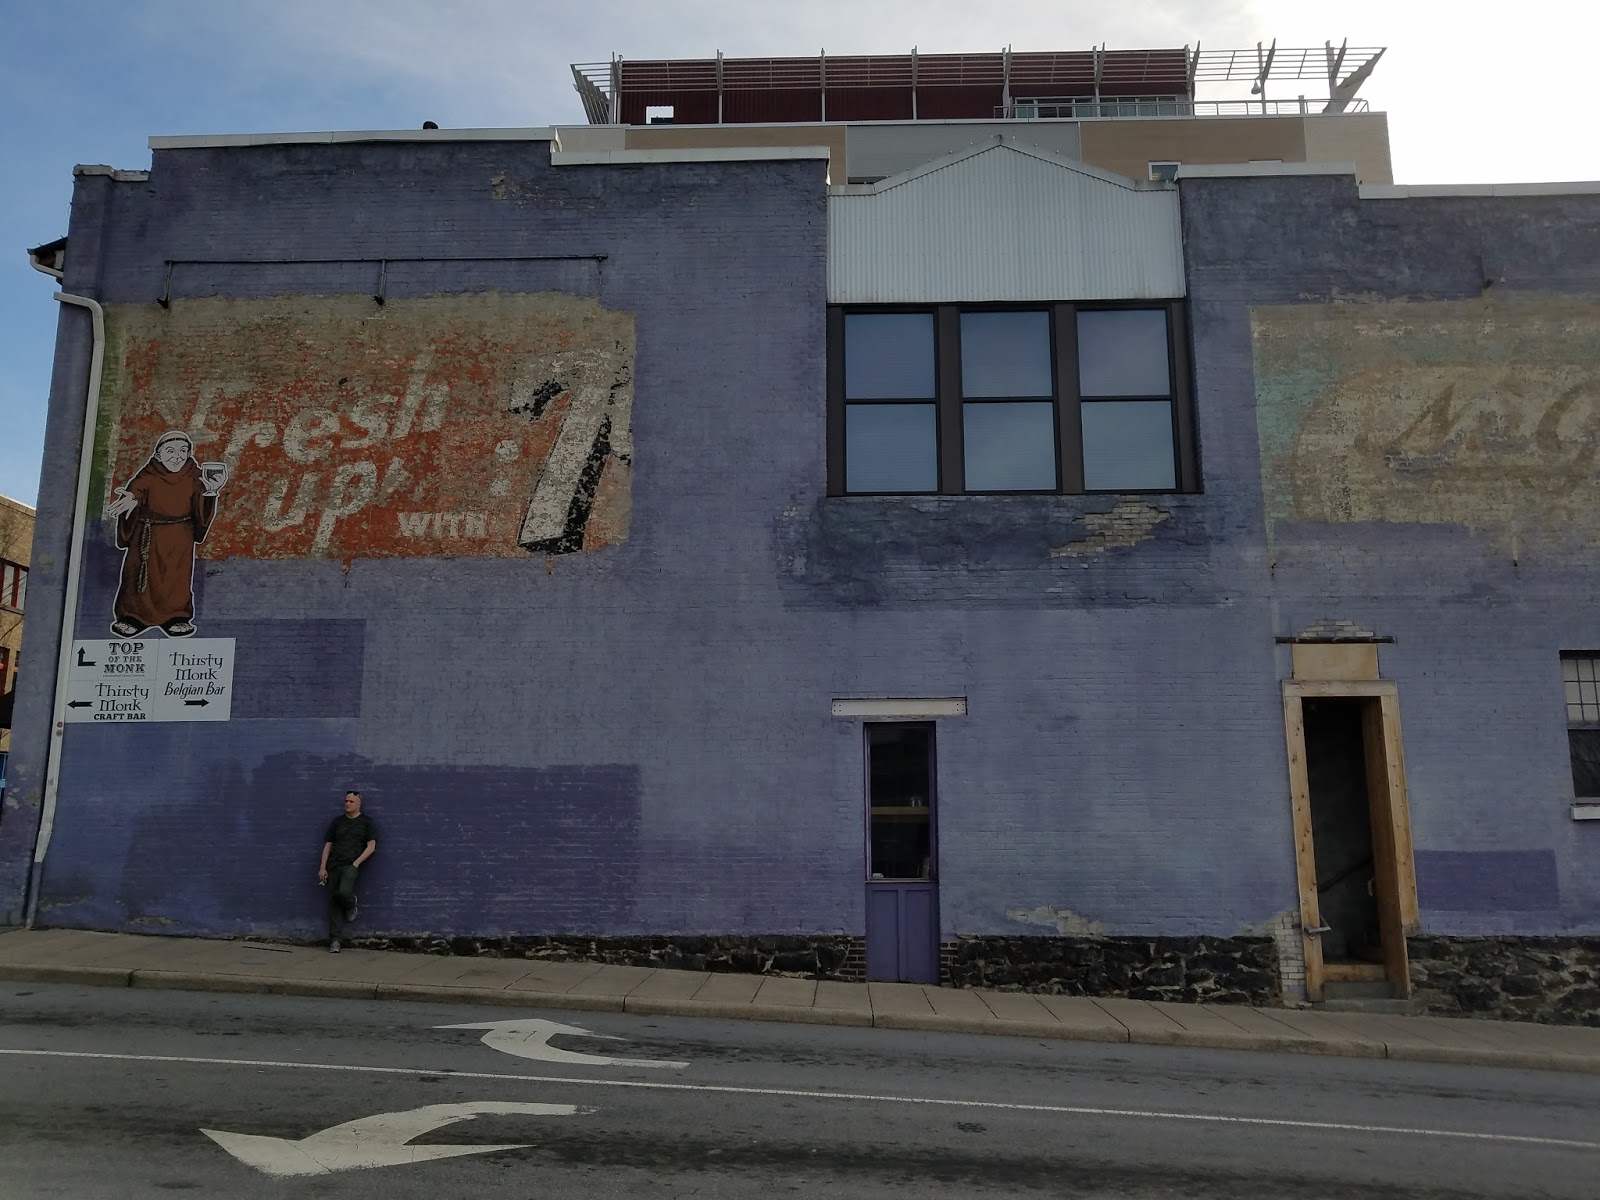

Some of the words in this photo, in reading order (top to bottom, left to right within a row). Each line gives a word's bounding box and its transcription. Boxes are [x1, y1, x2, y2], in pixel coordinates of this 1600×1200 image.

[108, 642, 145, 655] TOP
[103, 664, 146, 673] MONK
[175, 668, 218, 681] Monk
[164, 681, 203, 700] Belgian
[205, 681, 226, 696] Bar
[98, 699, 143, 712] Monk
[93, 713, 125, 721] CRAFT
